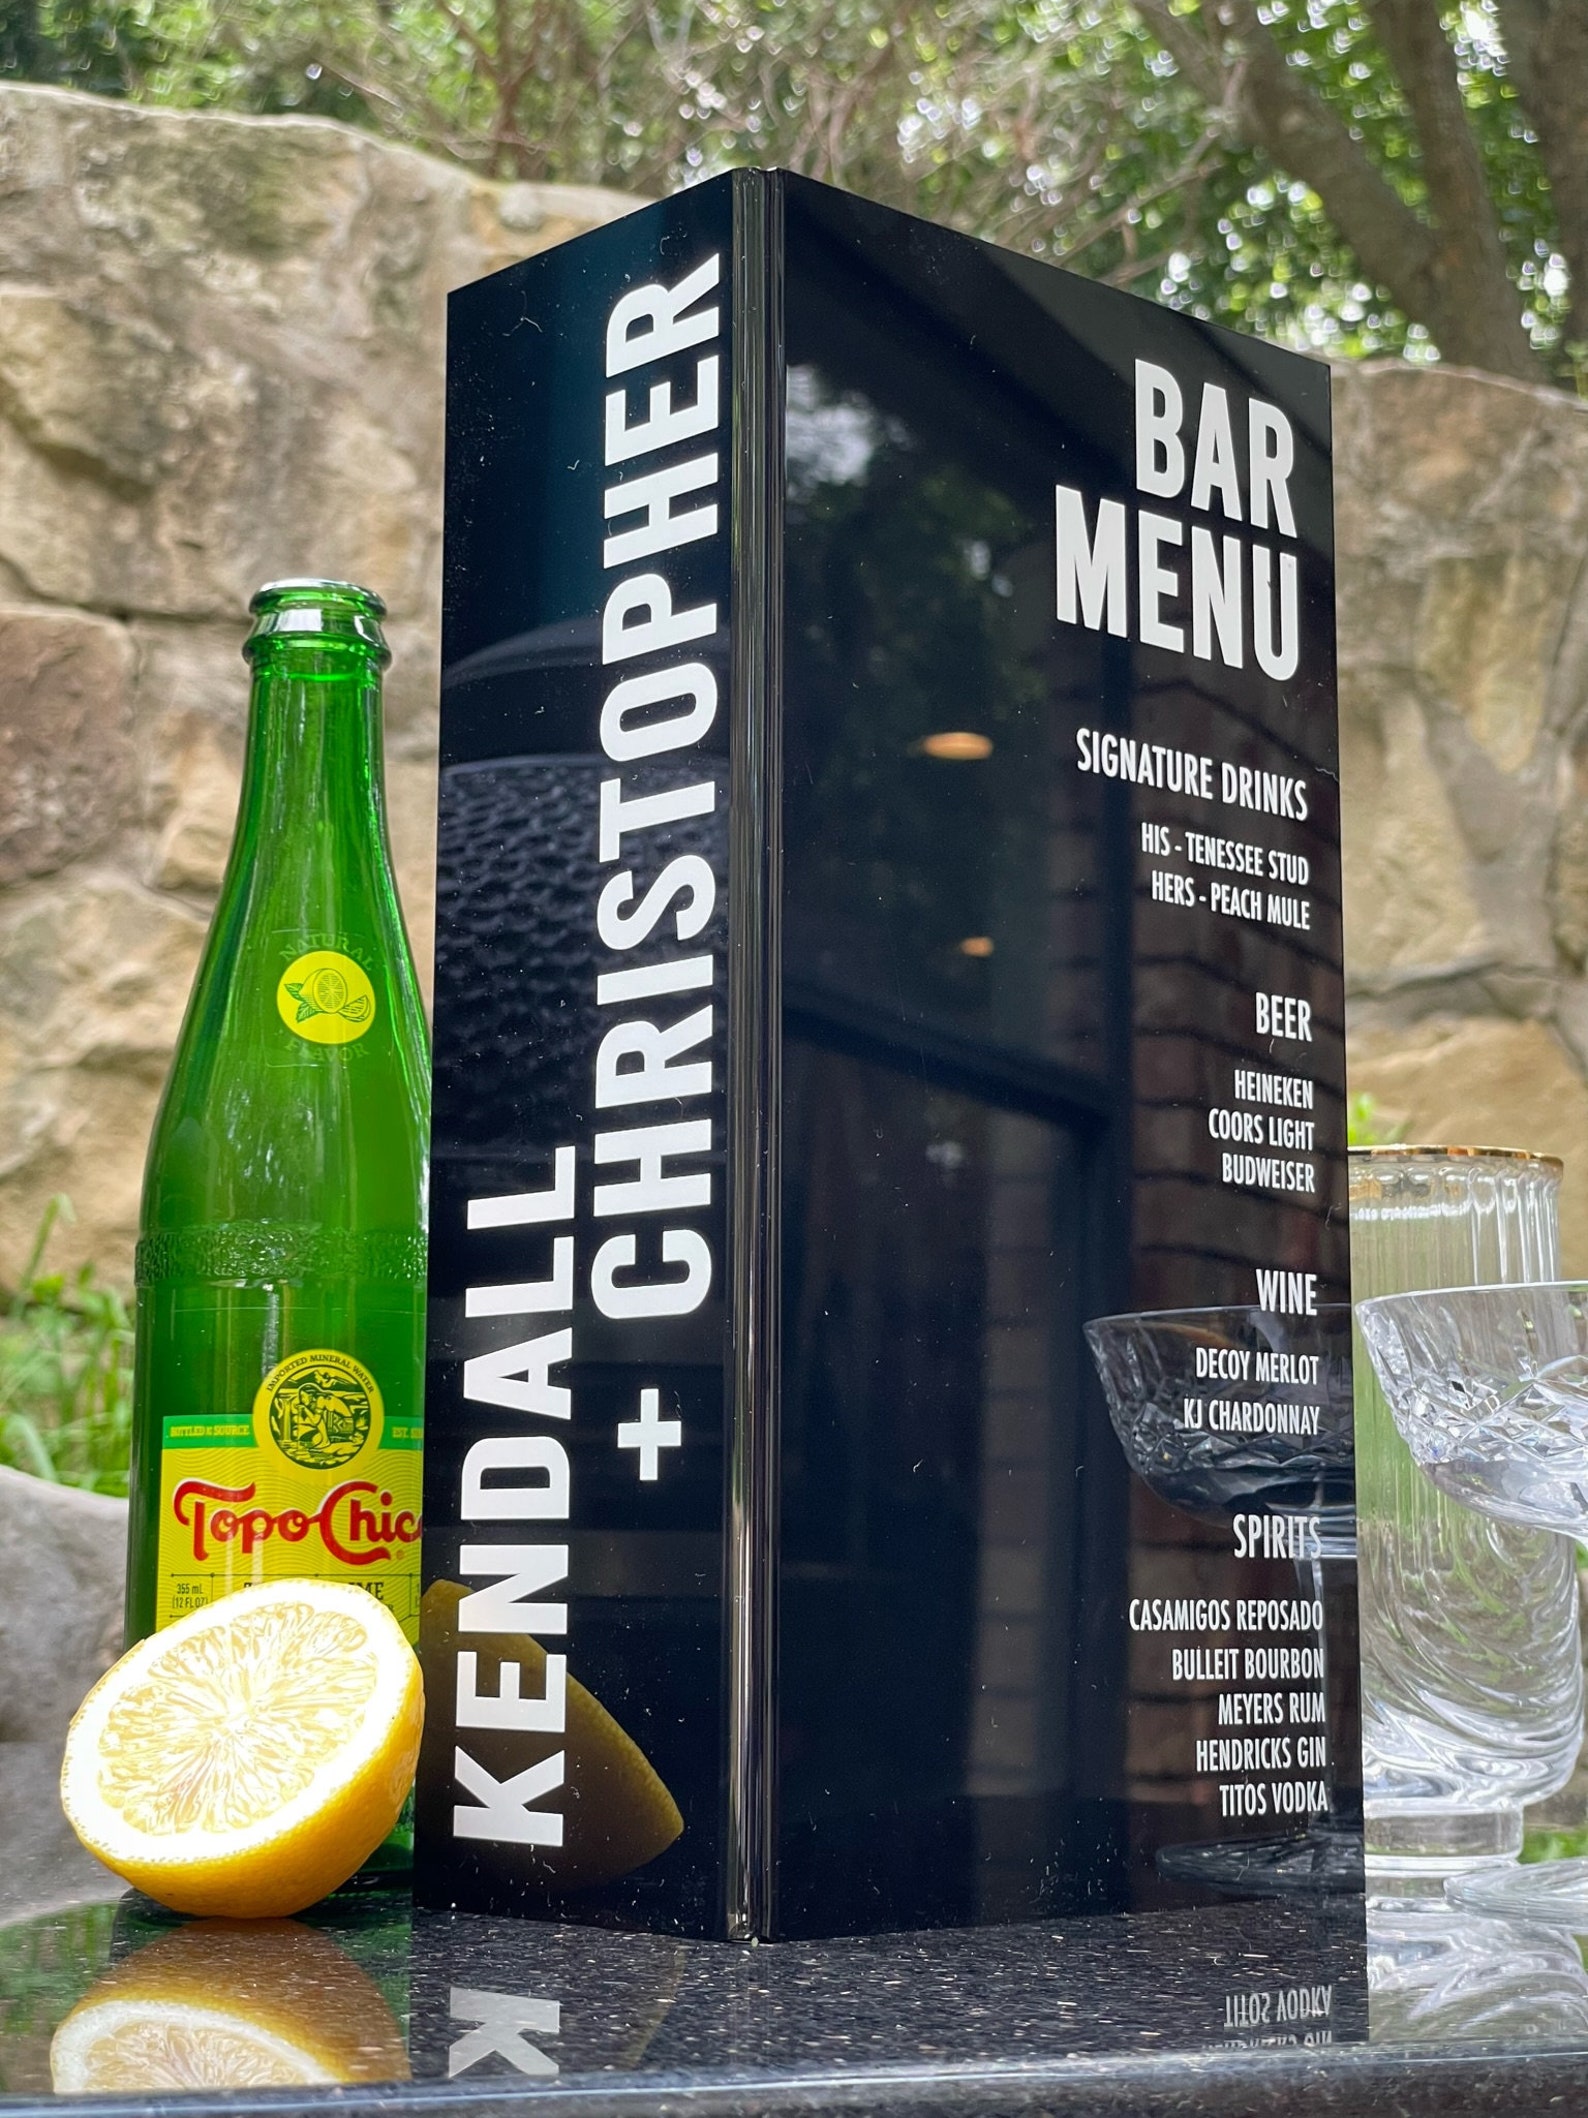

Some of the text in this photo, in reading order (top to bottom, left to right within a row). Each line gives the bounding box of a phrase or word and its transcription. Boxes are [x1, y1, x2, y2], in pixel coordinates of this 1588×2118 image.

[1134, 358, 1298, 539] BAR
[1055, 484, 1299, 681] MENU
[590, 252, 720, 1320] CHRISTOPHER
[1076, 727, 1308, 821] SIGNATURE DRINKS
[1141, 822, 1171, 857] HIS
[1185, 831, 1264, 877] TENESSEE
[1268, 849, 1309, 885] STUD
[1151, 869, 1195, 907] HERS
[1210, 882, 1262, 921] PEACH
[1267, 893, 1311, 931] MULE
[1255, 992, 1313, 1042] BEER
[1234, 1069, 1314, 1110] HEINEKEN
[1208, 1108, 1315, 1151] COORS LIGHT
[1222, 1152, 1316, 1193] BUDWEISER
[1255, 1268, 1318, 1316] WINE
[267, 1354, 375, 1393] IMPORTED MINERAL WATER
[1196, 1347, 1319, 1386] DECOY MERLOT
[1184, 1398, 1320, 1435] KJ CHARDONNAY
[453, 1145, 576, 1847] KENDALL
[173, 1477, 423, 1566] Topo Chic
[1232, 1514, 1322, 1558] SPIRITS
[176, 1583, 190, 1594] 355
[1129, 1598, 1324, 1631] CASAMIGOS REPOSADO
[1172, 1647, 1325, 1680] BULLEIT BOURBON
[1218, 1691, 1327, 1725] MEYERS RUM
[1196, 1735, 1327, 1772] HENDRICKS GIN
[1219, 1780, 1329, 1817] TITOS VODKA
